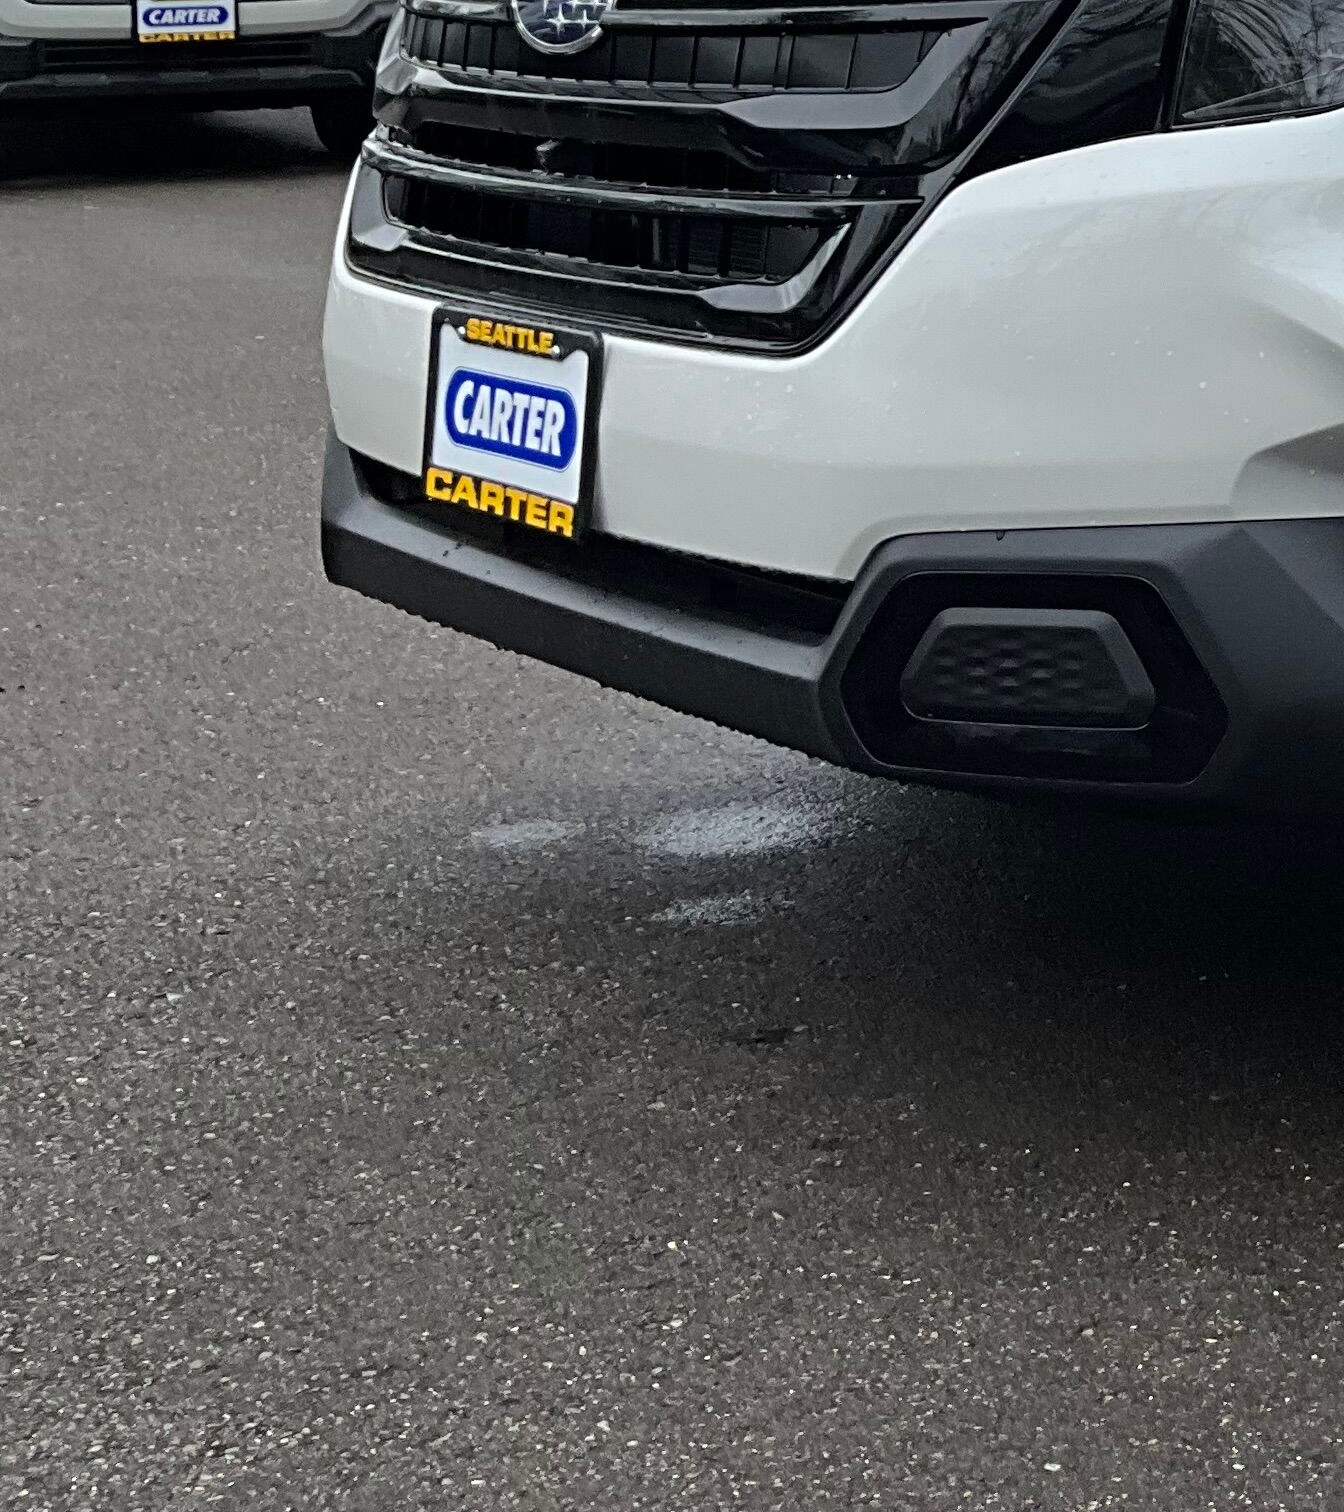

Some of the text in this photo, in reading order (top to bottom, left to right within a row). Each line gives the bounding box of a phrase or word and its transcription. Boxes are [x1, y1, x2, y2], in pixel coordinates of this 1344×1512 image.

[148, 7, 221, 25] CARTER
[466, 318, 554, 355] SEATTLE
[453, 379, 566, 458] CARTER
[425, 466, 576, 538] CARTER
